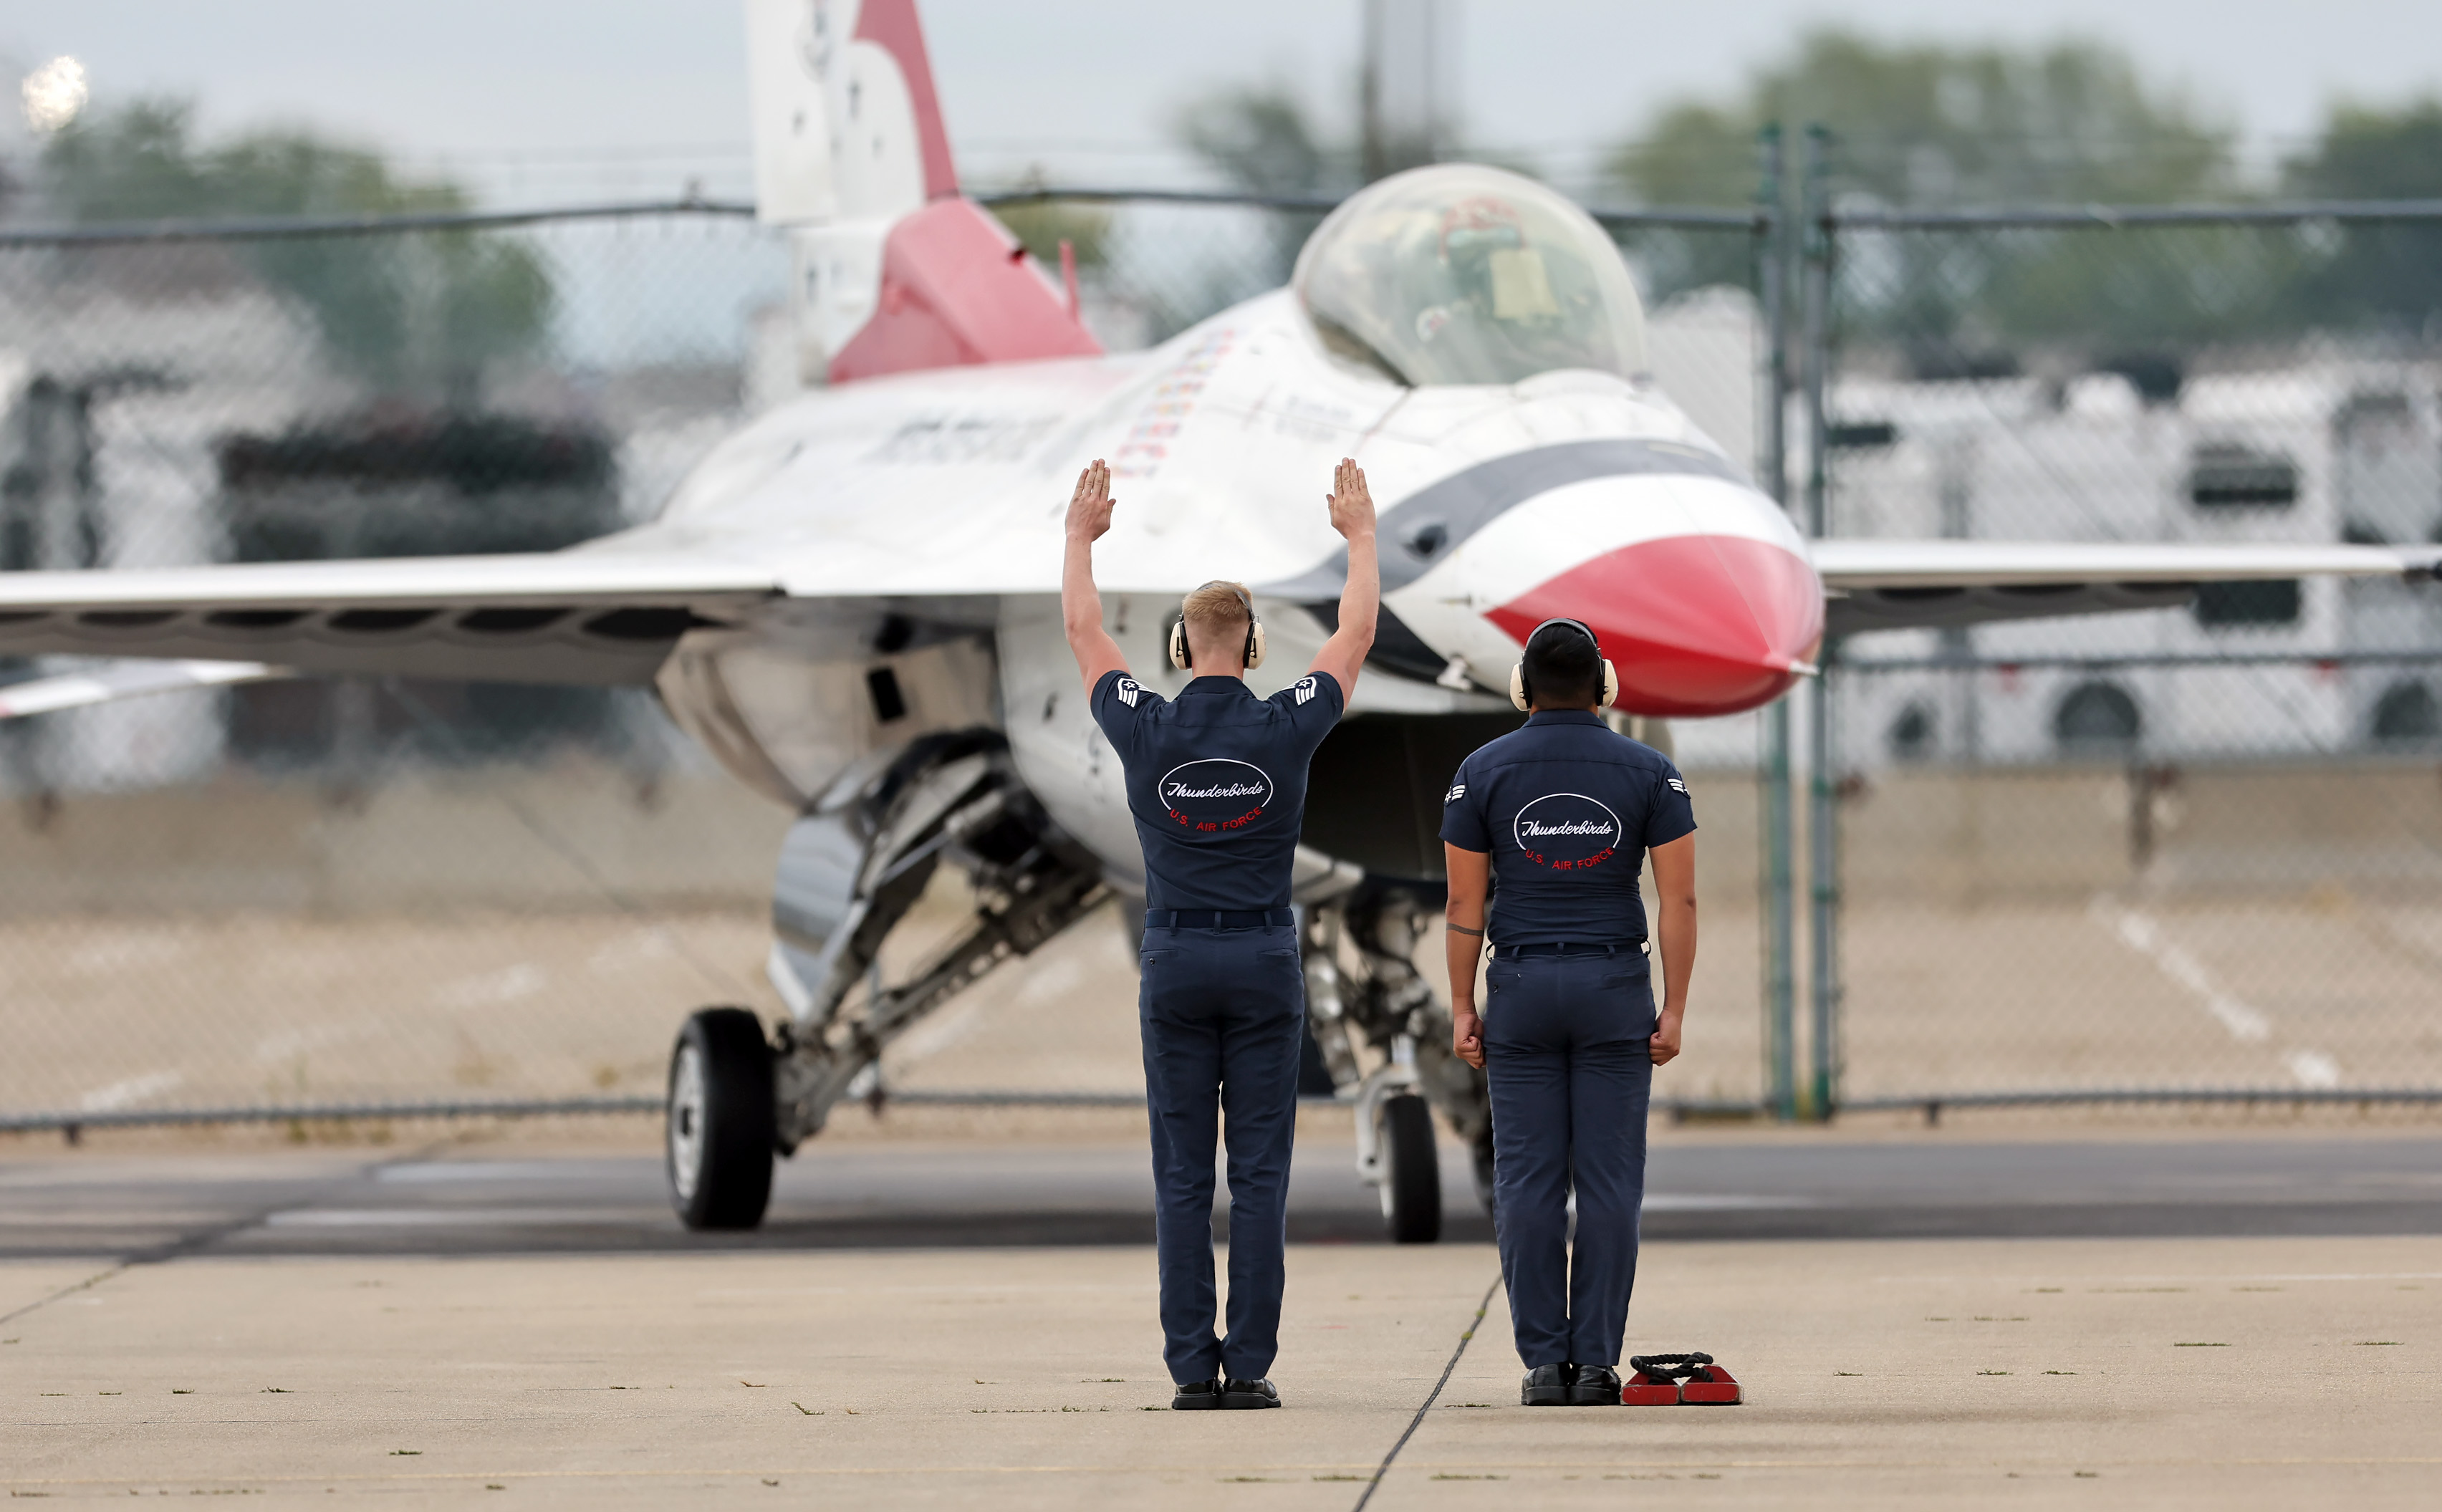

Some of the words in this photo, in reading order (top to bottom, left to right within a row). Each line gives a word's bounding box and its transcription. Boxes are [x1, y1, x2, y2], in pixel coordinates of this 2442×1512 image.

[1167, 781, 1265, 798] Thunderbirds
[1170, 809, 1189, 827] U.S.
[1196, 822, 1217, 832] AIR
[1222, 806, 1263, 831] FORCE
[1522, 820, 1613, 837] Thunderbirds
[1525, 849, 1544, 866] U.S.
[1552, 860, 1572, 870] AIR
[1577, 847, 1615, 870] FORCE
